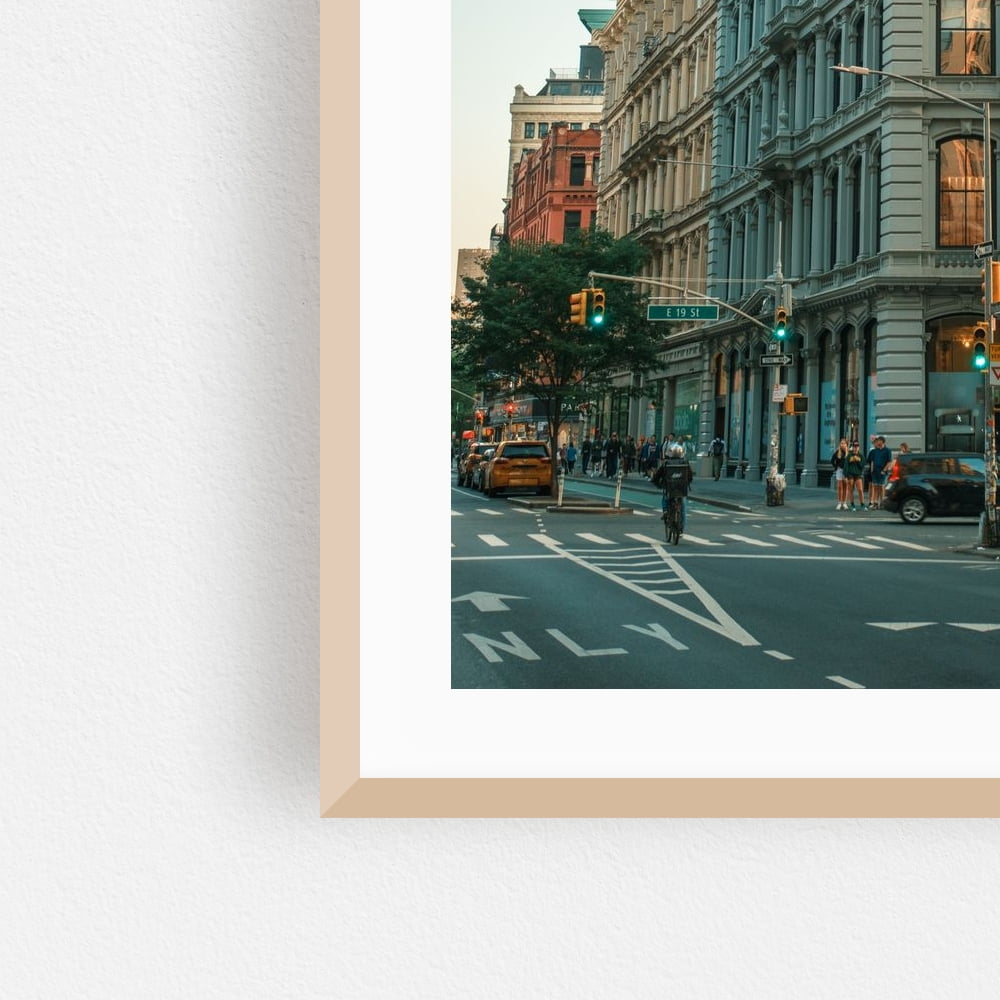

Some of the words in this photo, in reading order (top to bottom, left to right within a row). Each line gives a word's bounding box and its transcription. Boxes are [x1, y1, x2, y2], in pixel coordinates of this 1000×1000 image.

[666, 308, 672, 317] E
[676, 307, 686, 317] 19
[690, 308, 700, 317] St
